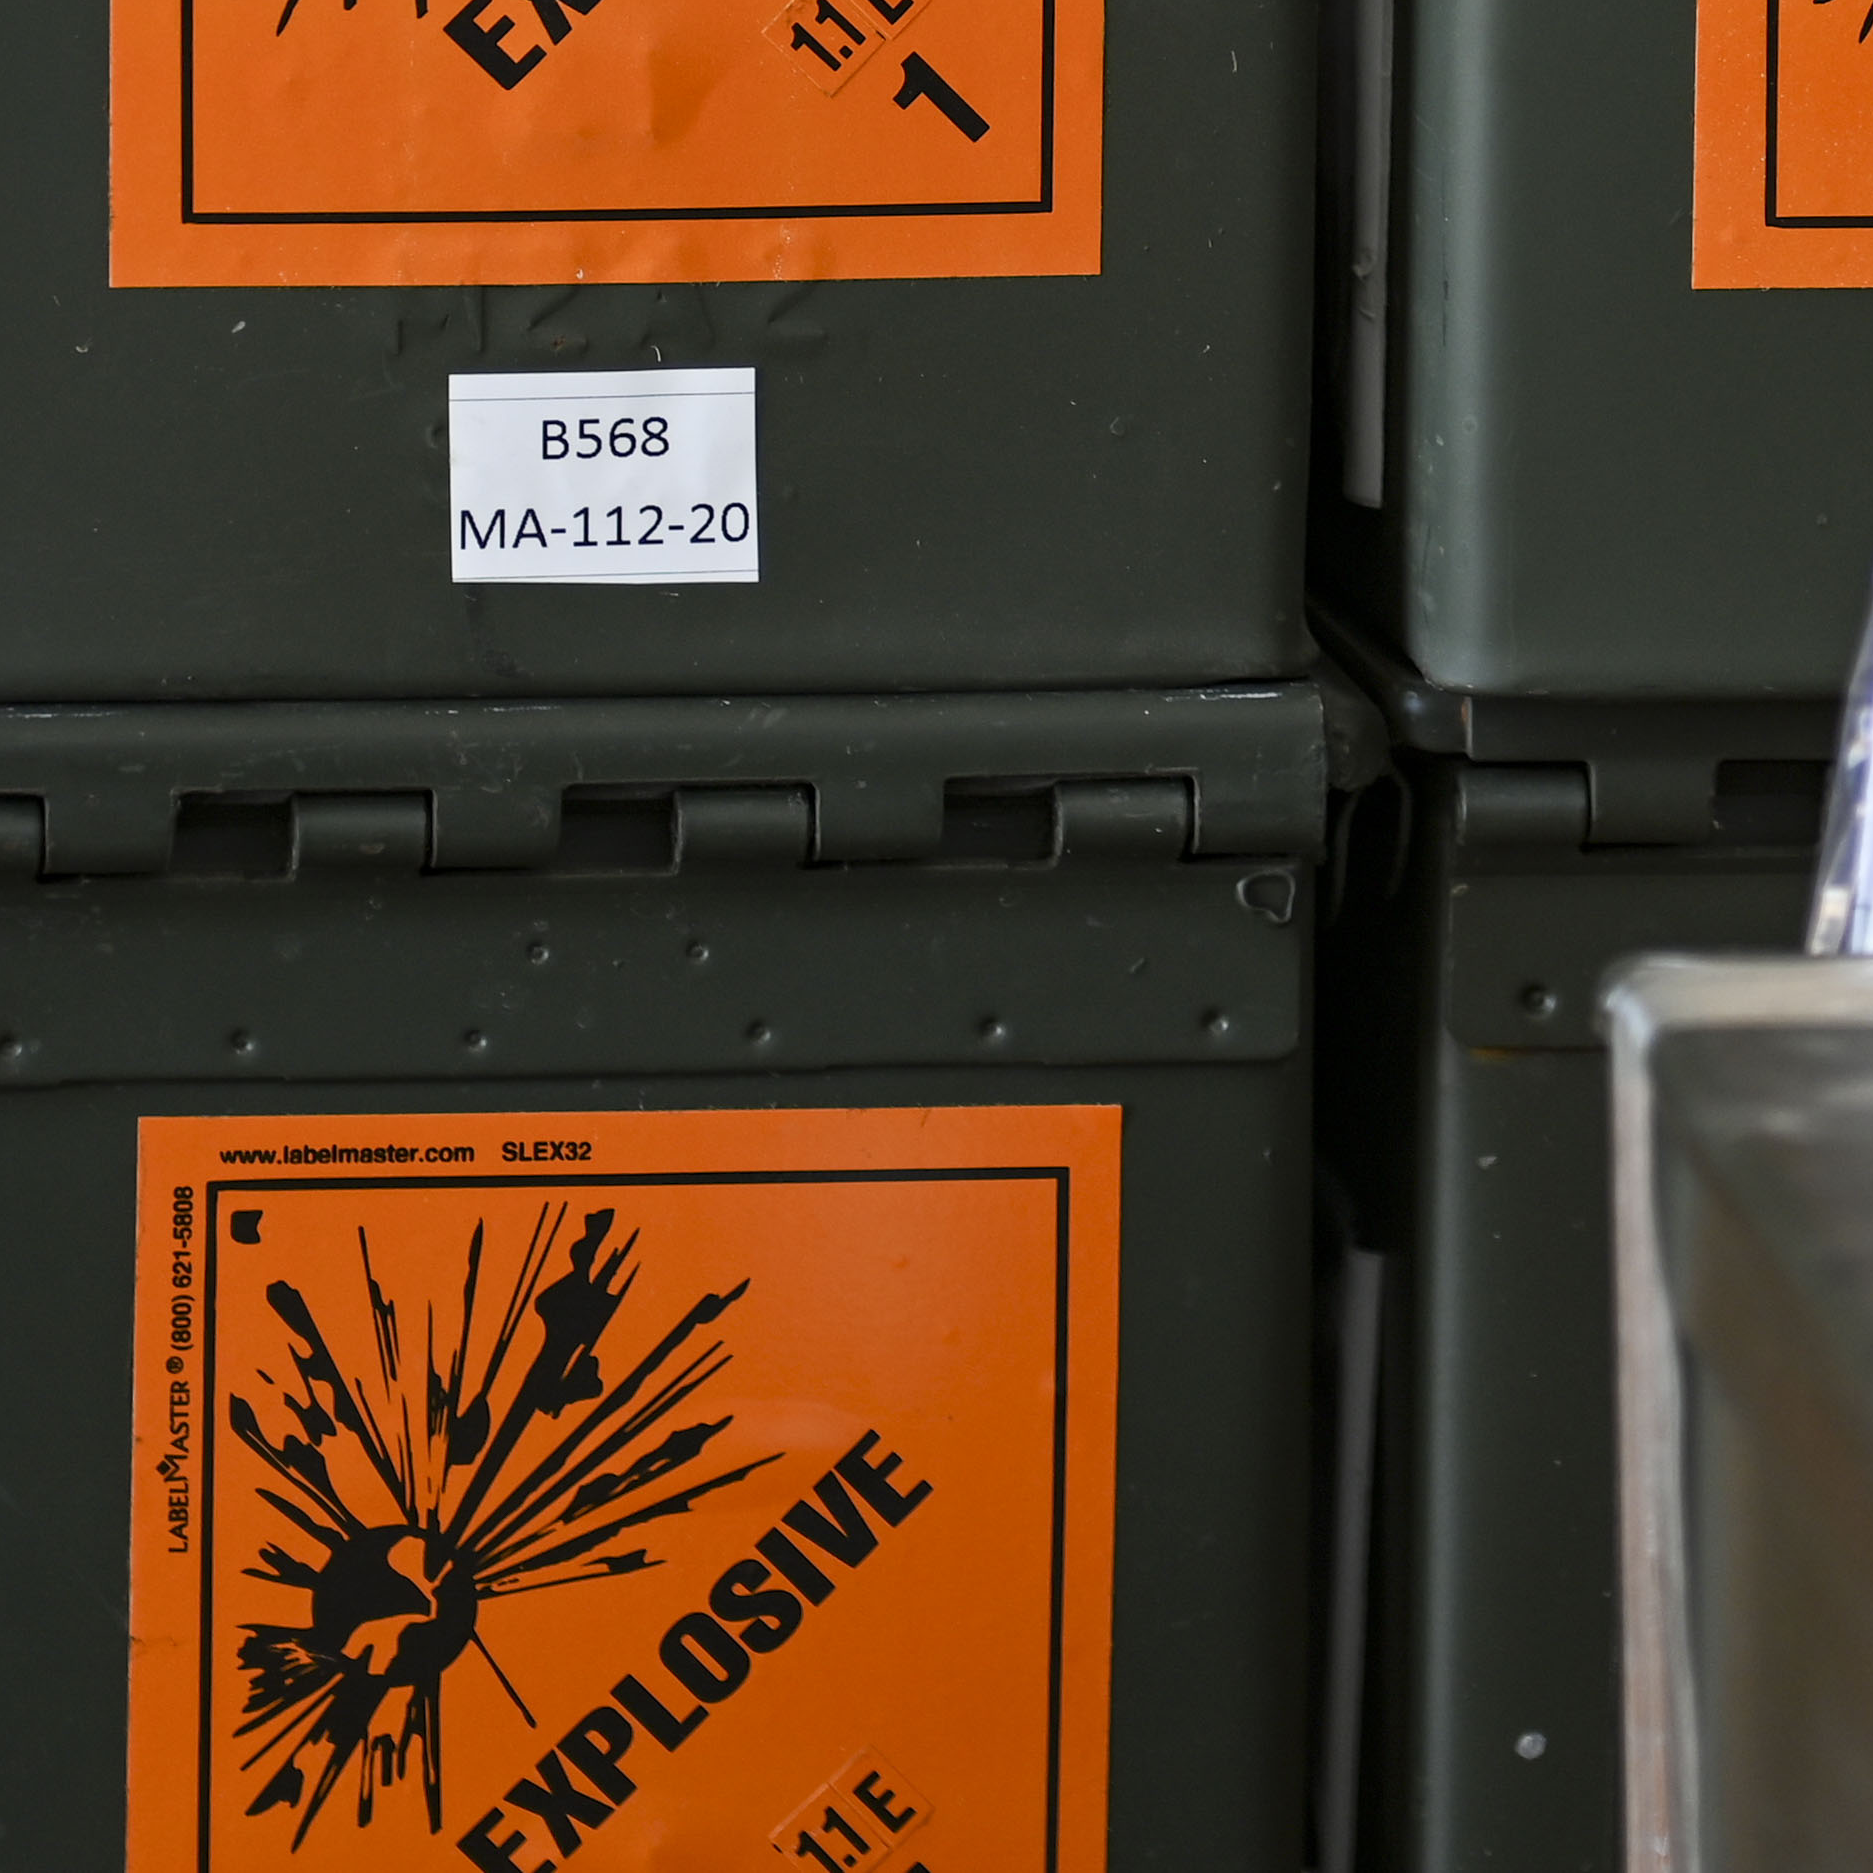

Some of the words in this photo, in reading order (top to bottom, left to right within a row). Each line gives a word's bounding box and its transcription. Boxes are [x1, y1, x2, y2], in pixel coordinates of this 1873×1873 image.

[892, 50, 991, 143] 1
[540, 415, 671, 461] B568
[458, 500, 752, 551] MA-112-20
[219, 1143, 476, 1165] www.labelmaster.com
[501, 1140, 593, 1162] SLEX32
[171, 1184, 194, 1289] 621-5808
[171, 1294, 195, 1351] (800)
[455, 1428, 934, 1873] EXPLOSIVE
[852, 1770, 917, 1834] E
